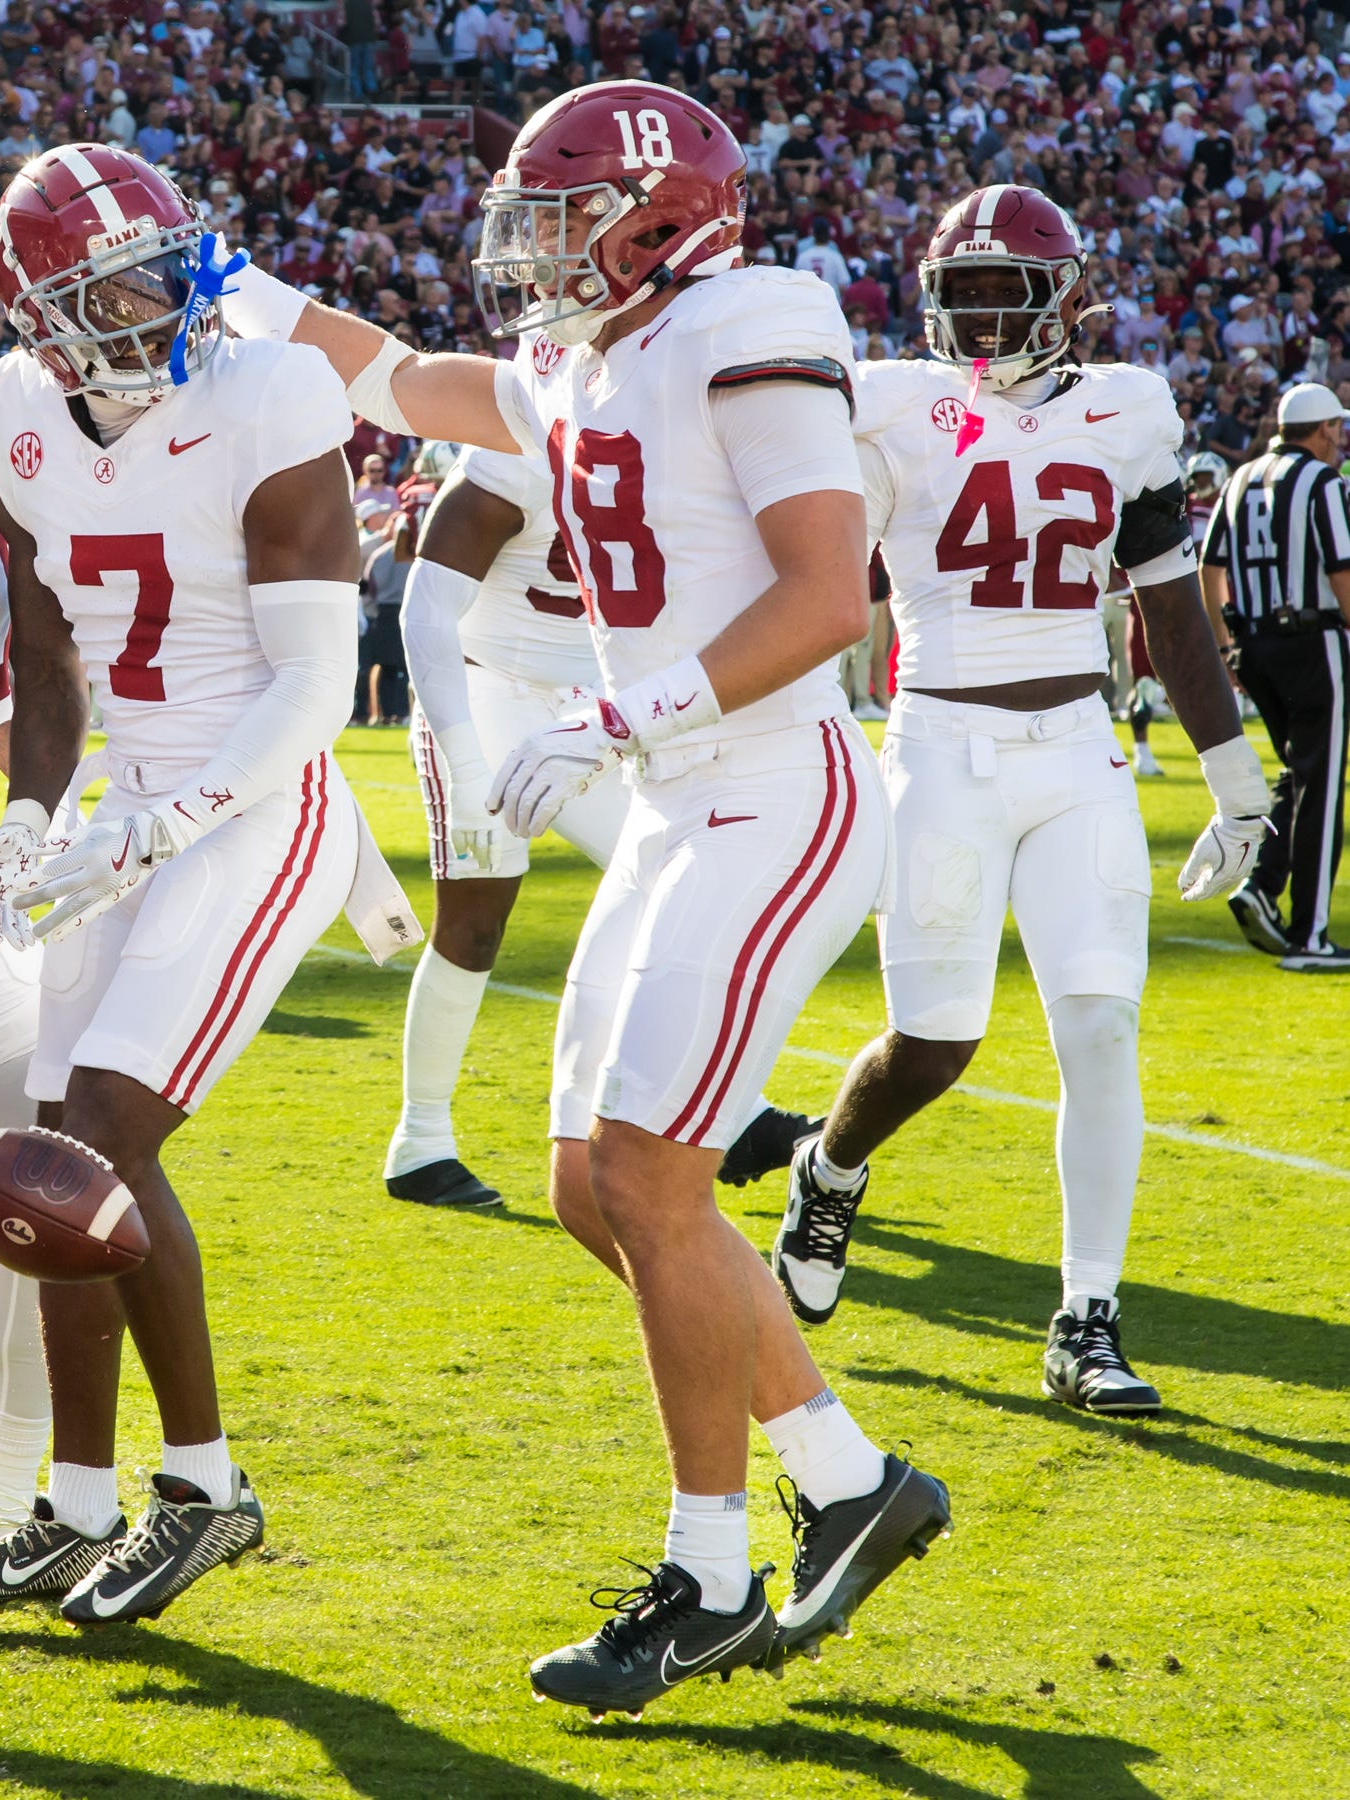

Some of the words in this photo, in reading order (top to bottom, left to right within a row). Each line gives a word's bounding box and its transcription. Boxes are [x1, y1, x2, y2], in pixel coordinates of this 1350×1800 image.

[613, 109, 673, 169] 18
[106, 227, 140, 249] BAMA
[965, 242, 993, 252] BAMA
[933, 398, 967, 431] SE
[11, 433, 43, 478] SEC
[97, 461, 112, 478] A
[547, 418, 666, 627] 18
[935, 460, 1115, 609] 42
[1245, 488, 1278, 561] R
[70, 533, 174, 701] 7
[199, 786, 235, 813] A
